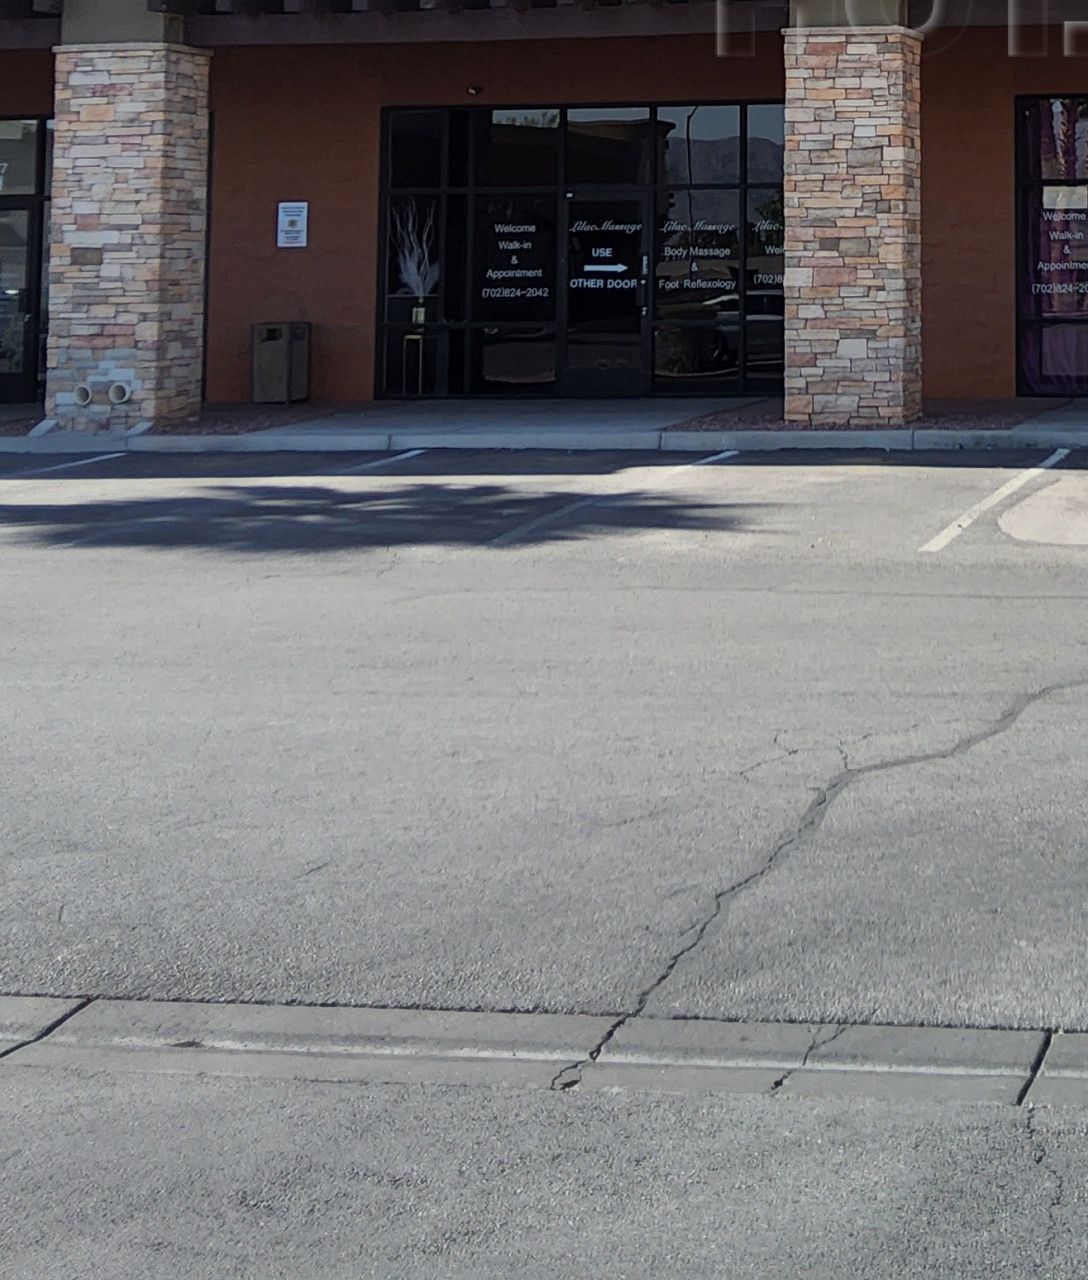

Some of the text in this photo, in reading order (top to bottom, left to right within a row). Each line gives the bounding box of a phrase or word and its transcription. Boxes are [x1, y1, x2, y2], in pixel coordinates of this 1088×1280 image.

[1042, 211, 1087, 221] Welcome
[494, 223, 536, 234] Welcome
[1049, 231, 1084, 240] Walk-in
[498, 240, 532, 250] Walk-in
[1062, 244, 1071, 255] &
[591, 247, 613, 257] USE
[664, 246, 731, 258] Body Massage
[510, 255, 518, 265] &
[690, 262, 699, 272] &
[486, 268, 543, 280] Appointment
[569, 278, 638, 289] OTHER DOOR
[658, 278, 737, 291] Foot Reflexology
[481, 287, 549, 298] (702)824-2042
